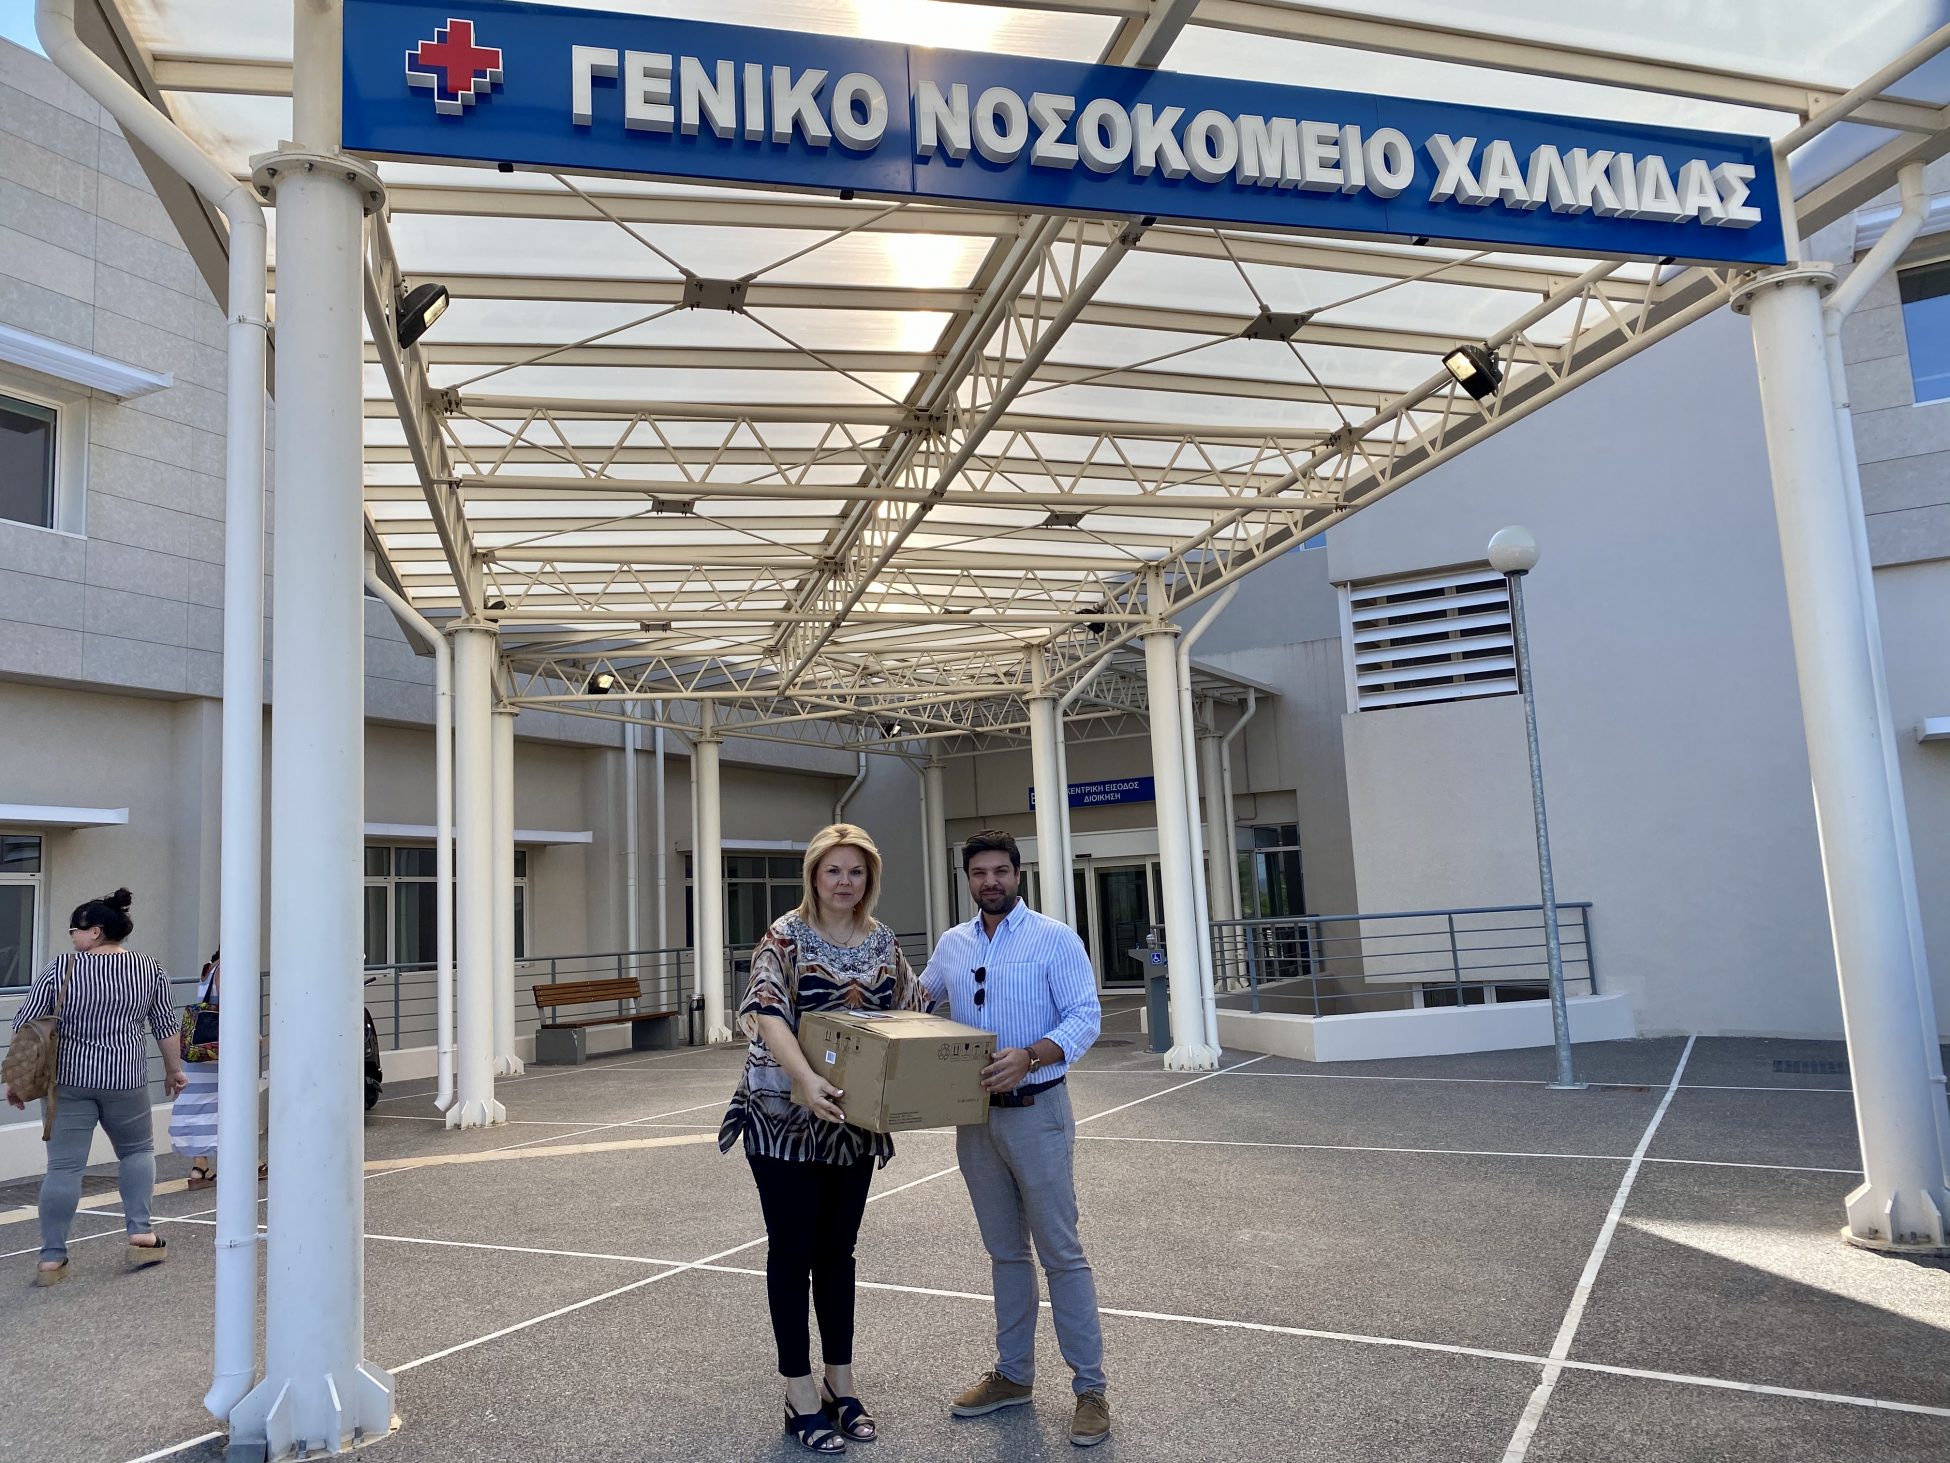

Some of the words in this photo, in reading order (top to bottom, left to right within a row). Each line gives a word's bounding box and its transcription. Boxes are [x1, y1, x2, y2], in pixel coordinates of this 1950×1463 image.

[572, 44, 889, 151] ΓΕΝΙΚΟ
[914, 79, 1415, 199] ΝΟΣΟΚΟΜΕΙΟ
[1424, 133, 1764, 231] ΧΑΛΚΙΔΑΣ
[1105, 781, 1140, 792] ΕΙΣΟΔΟΣ
[1083, 793, 1121, 803] ΔΙΟΙΚΗΣΗ
